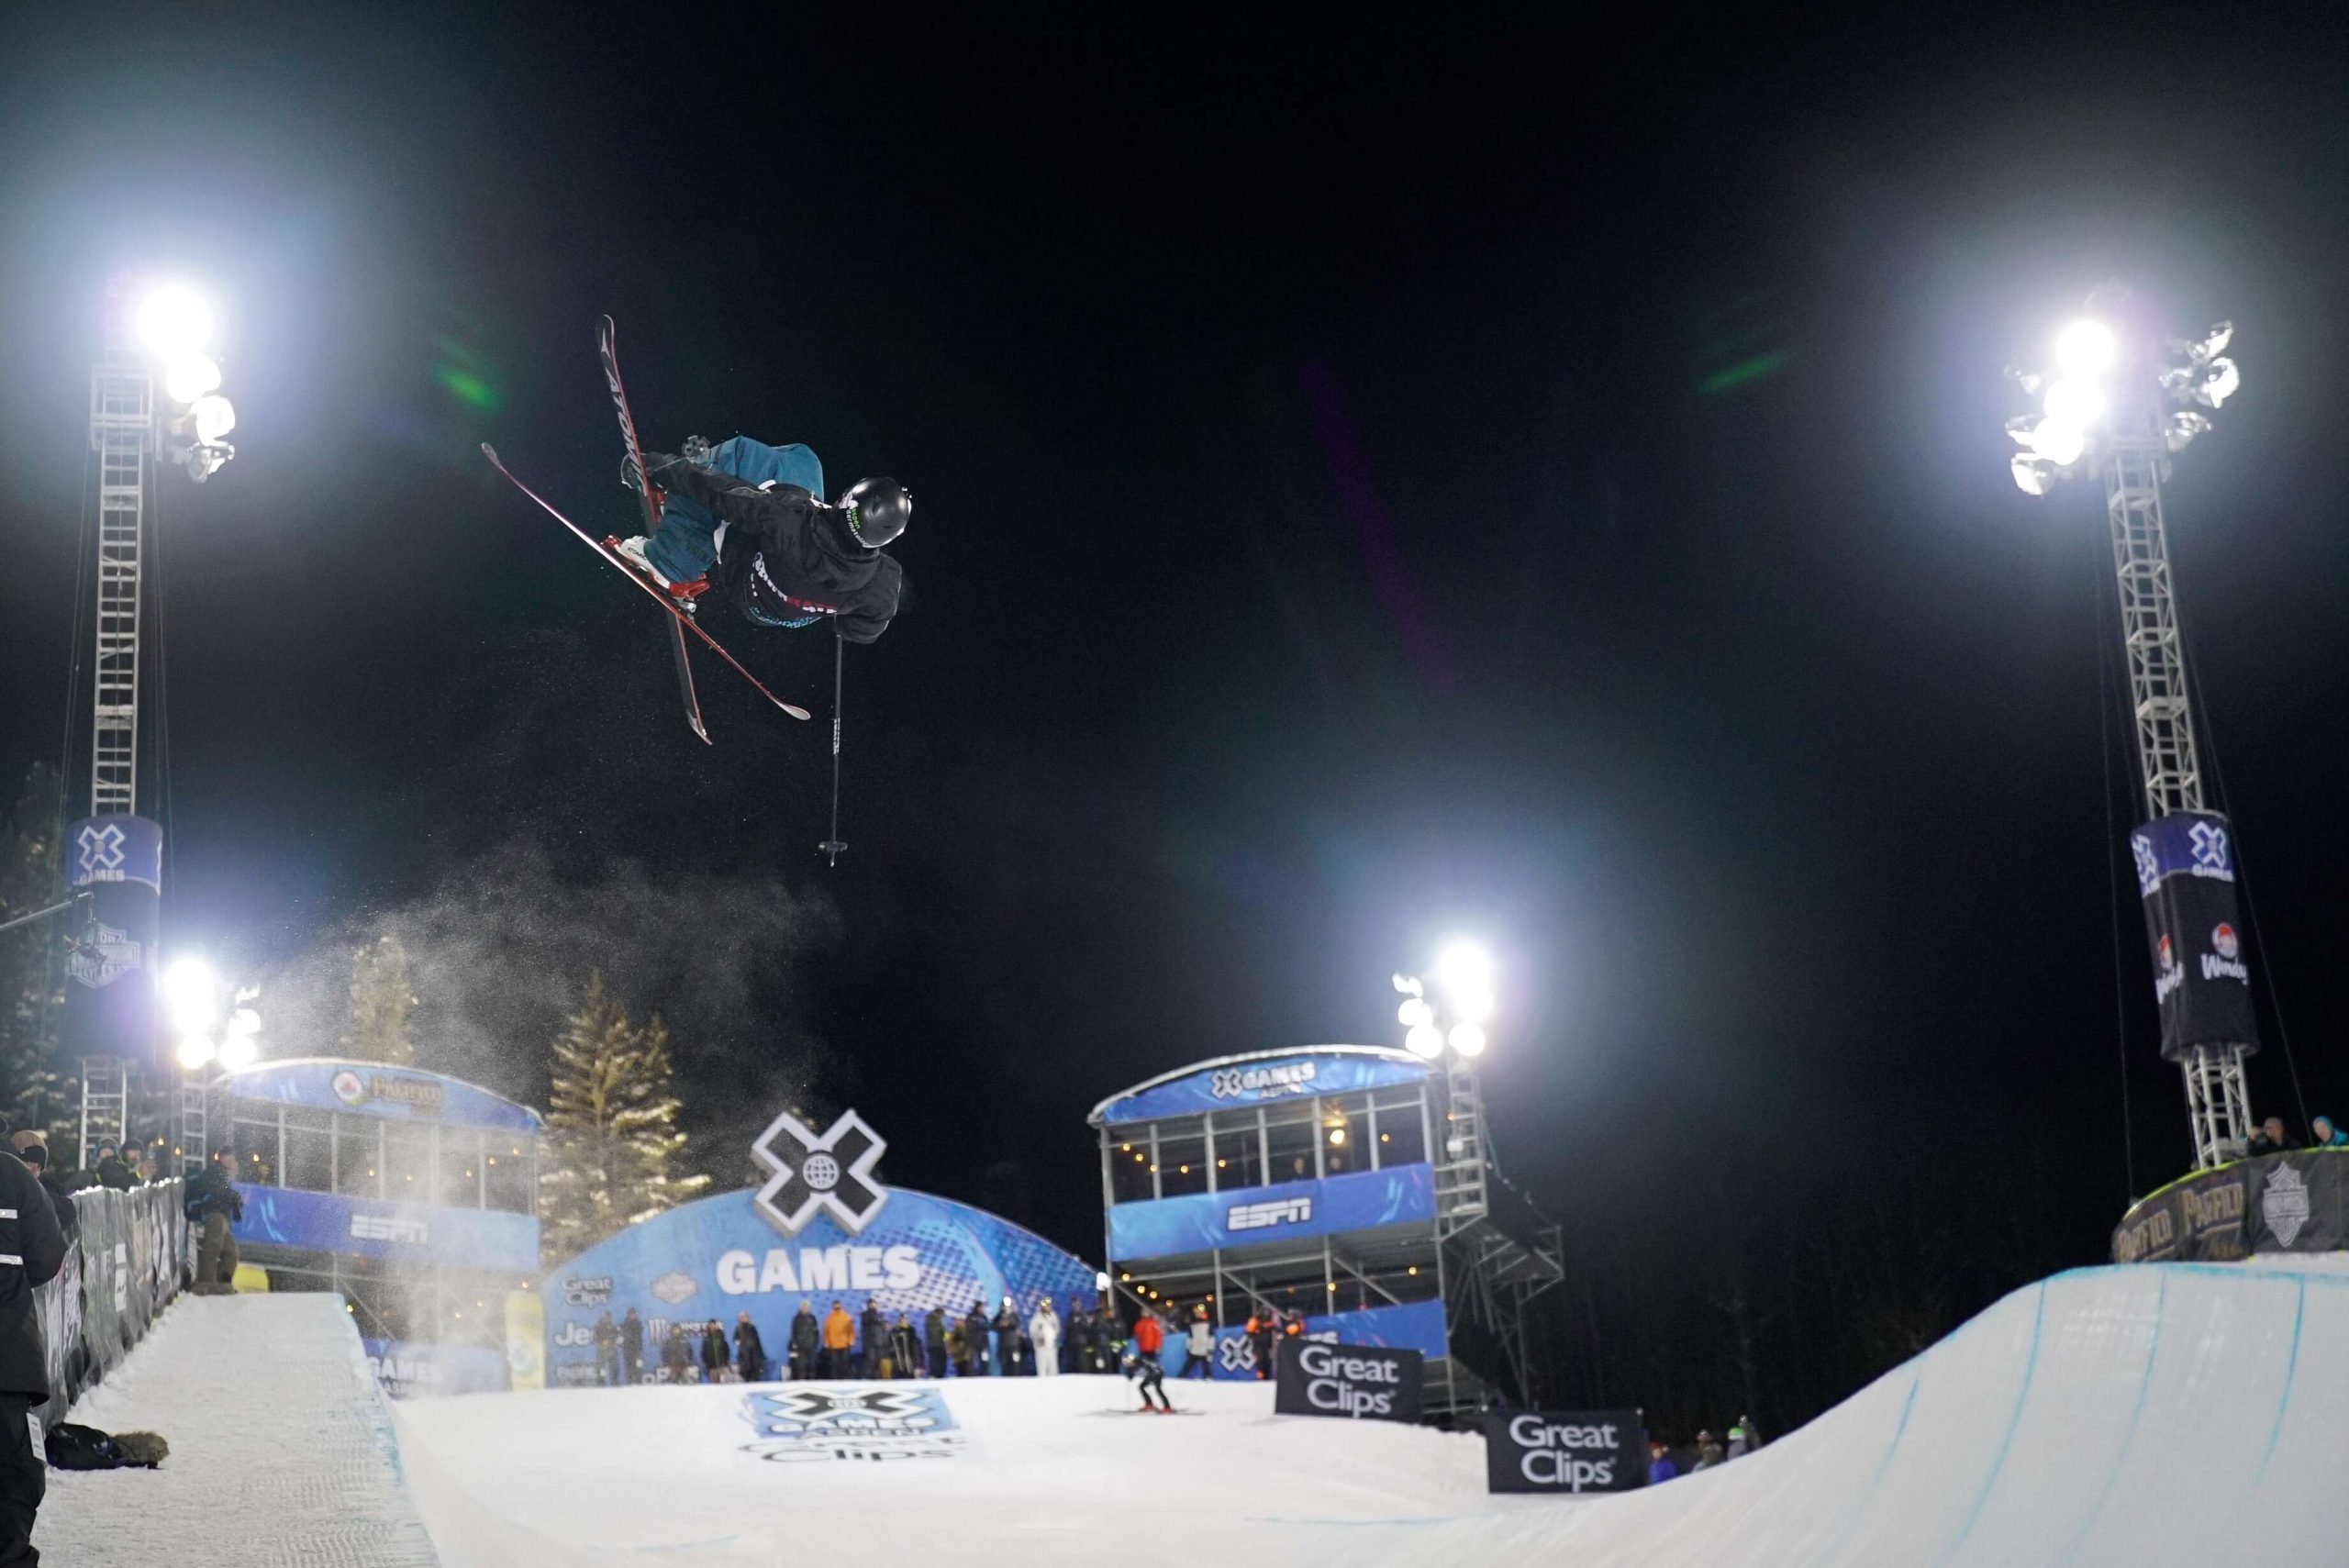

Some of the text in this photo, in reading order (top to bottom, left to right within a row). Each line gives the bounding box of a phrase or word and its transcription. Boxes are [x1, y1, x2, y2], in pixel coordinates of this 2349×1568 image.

[1242, 1062, 1316, 1089] GAMES
[351, 1215, 429, 1244] ESPN
[1228, 1197, 1311, 1230] ESPN
[716, 1243, 920, 1296] GAMES
[1299, 1346, 1399, 1384] Great
[1307, 1379, 1392, 1418] Clips
[1508, 1415, 1619, 1449] Great
[1520, 1449, 1613, 1494] Clips
